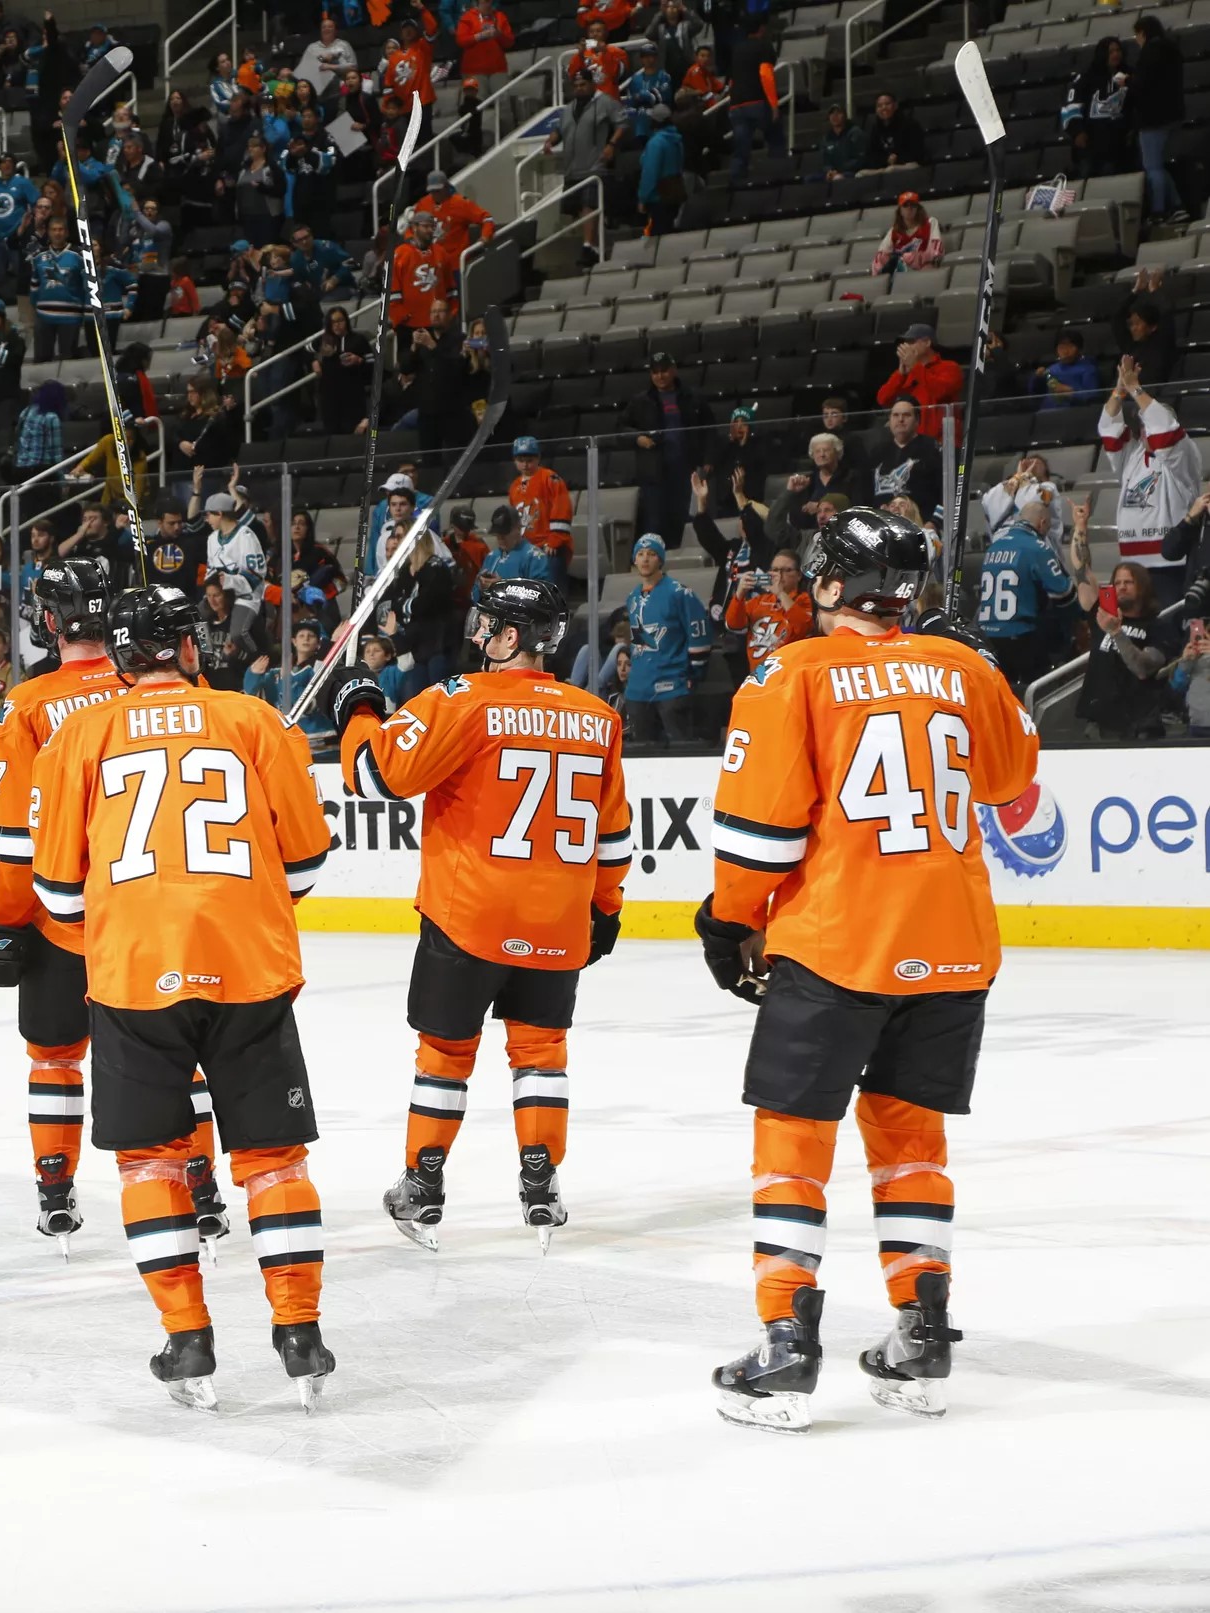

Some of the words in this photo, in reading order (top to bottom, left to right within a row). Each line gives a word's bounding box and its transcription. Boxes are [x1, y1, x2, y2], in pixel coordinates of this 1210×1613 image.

[76, 218, 102, 309] CCM
[975, 257, 995, 375] CCM
[127, 509, 141, 552] CCM
[245, 553, 266, 570] 62
[88, 598, 103, 614] 67
[894, 582, 915, 599] 46
[978, 569, 1019, 622] 26
[112, 626, 130, 646] 72
[690, 619, 707, 638] 31
[81, 671, 117, 681] CCM
[533, 685, 564, 697] CCM
[828, 661, 967, 707] HELEWKA
[127, 703, 204, 739] HEED
[379, 708, 429, 751] 75
[485, 706, 614, 748] BRODZINSKI
[722, 728, 751, 774] 6
[837, 710, 972, 857] 46
[28, 786, 42, 829] 2
[99, 746, 253, 886] 72
[489, 747, 605, 865] 75
[1090, 795, 1210, 873] pe
[536, 947, 567, 957] CCM
[936, 963, 982, 974] CCM
[186, 973, 222, 985] CCM
[41, 1157, 63, 1166] CCM
